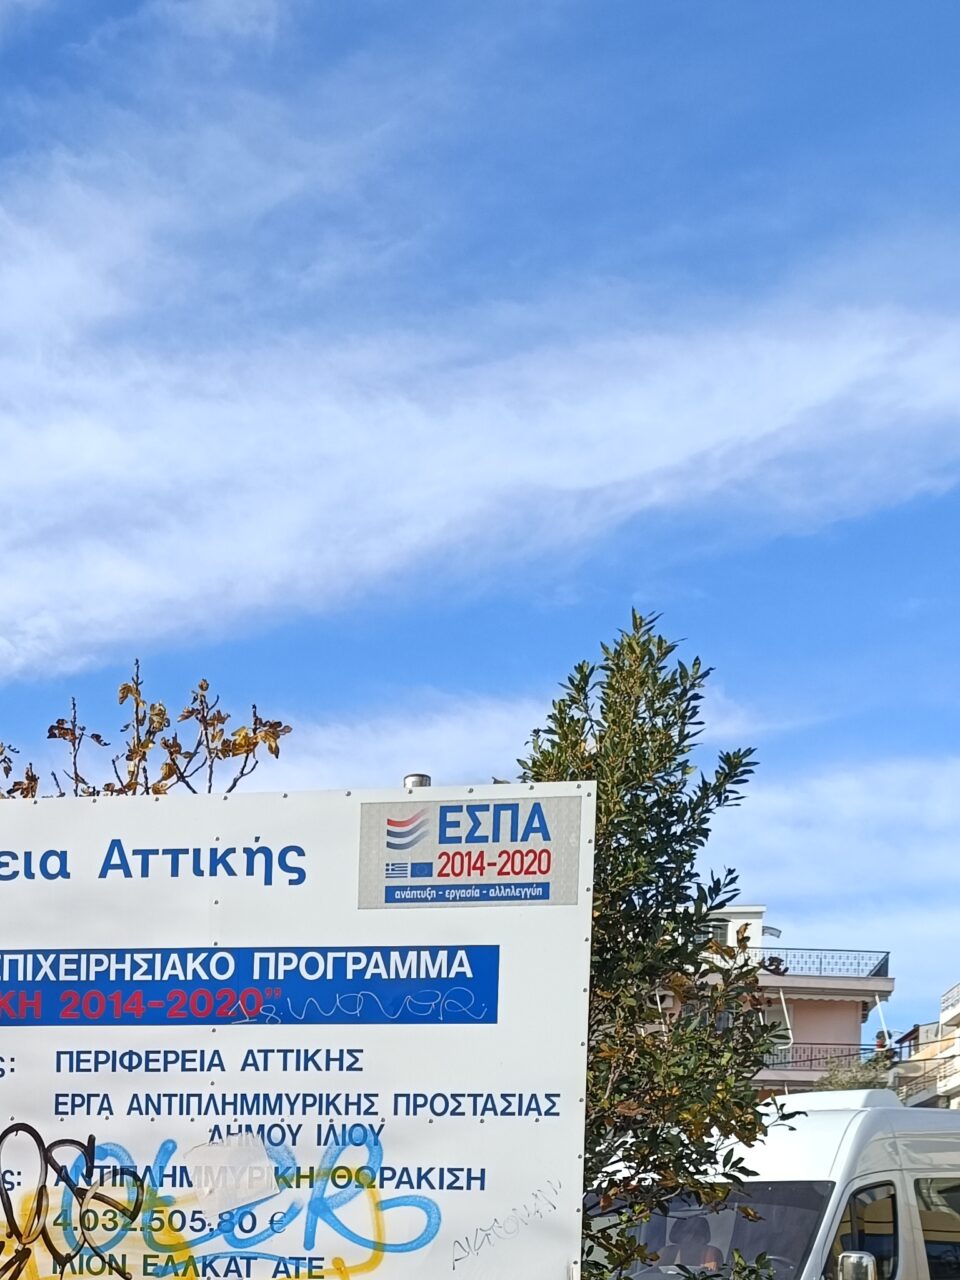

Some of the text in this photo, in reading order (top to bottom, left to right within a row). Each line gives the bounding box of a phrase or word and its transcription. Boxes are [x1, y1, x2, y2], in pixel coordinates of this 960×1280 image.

[438, 802, 551, 844] ΕΣΠΑ
[98, 836, 307, 886] Αττικής
[437, 848, 552, 878] 2014-2020
[394, 887, 437, 901] ανάπτυξη
[445, 885, 480, 900] εργασία
[489, 884, 543, 899] αλληλεγγύη
[253, 949, 473, 980] ΠΡΟΓΡΑΜΜΑ
[55, 1048, 225, 1073] ΠΕΡΙΦΕΡΕΙΑ
[240, 1048, 364, 1072] ΑΤΤΙΚΗΣ
[54, 1093, 114, 1116] ΕΡΓΑ
[126, 1093, 379, 1117] ΑΝΤΙΠΛΗΜΜΥΡΙΚΗΣ
[393, 1093, 561, 1117] ΠΡΟΣΤΑΣΙΑΣ
[317, 1123, 385, 1147] ΙΛΙΟΥ
[330, 1165, 486, 1191] ΘΩΡΑΚΙΣΗ
[269, 1210, 288, 1234] €
[272, 1256, 325, 1279] ΑΤΕ
